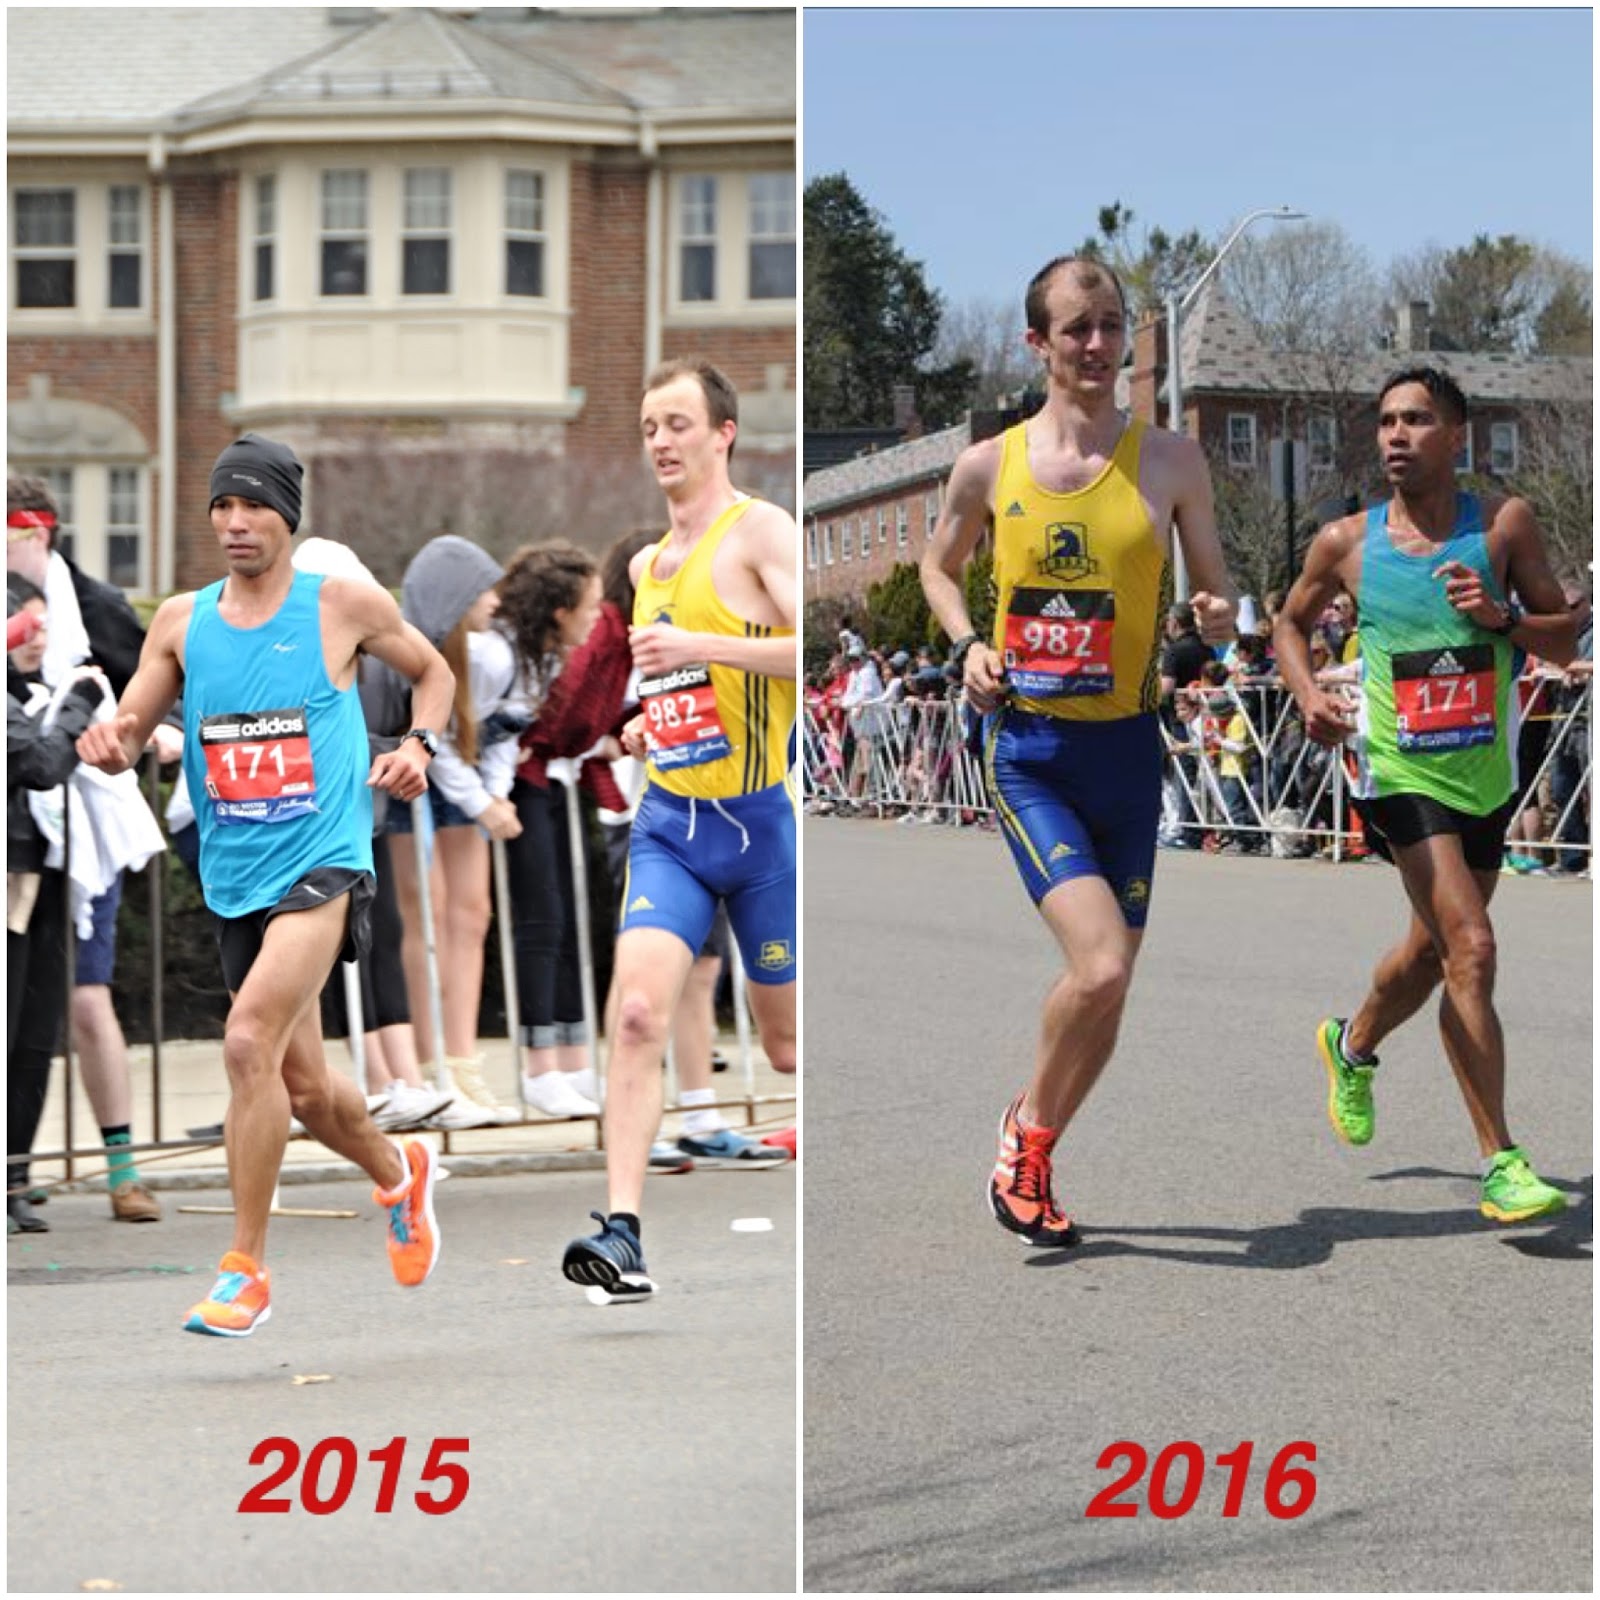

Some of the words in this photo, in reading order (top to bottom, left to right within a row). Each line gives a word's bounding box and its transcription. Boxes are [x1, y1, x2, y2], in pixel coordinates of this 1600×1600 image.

[1024, 621, 1093, 657] 982
[648, 694, 702, 731] 982
[1416, 679, 1478, 714] 171
[241, 717, 303, 736] adidas
[221, 743, 285, 781] 171
